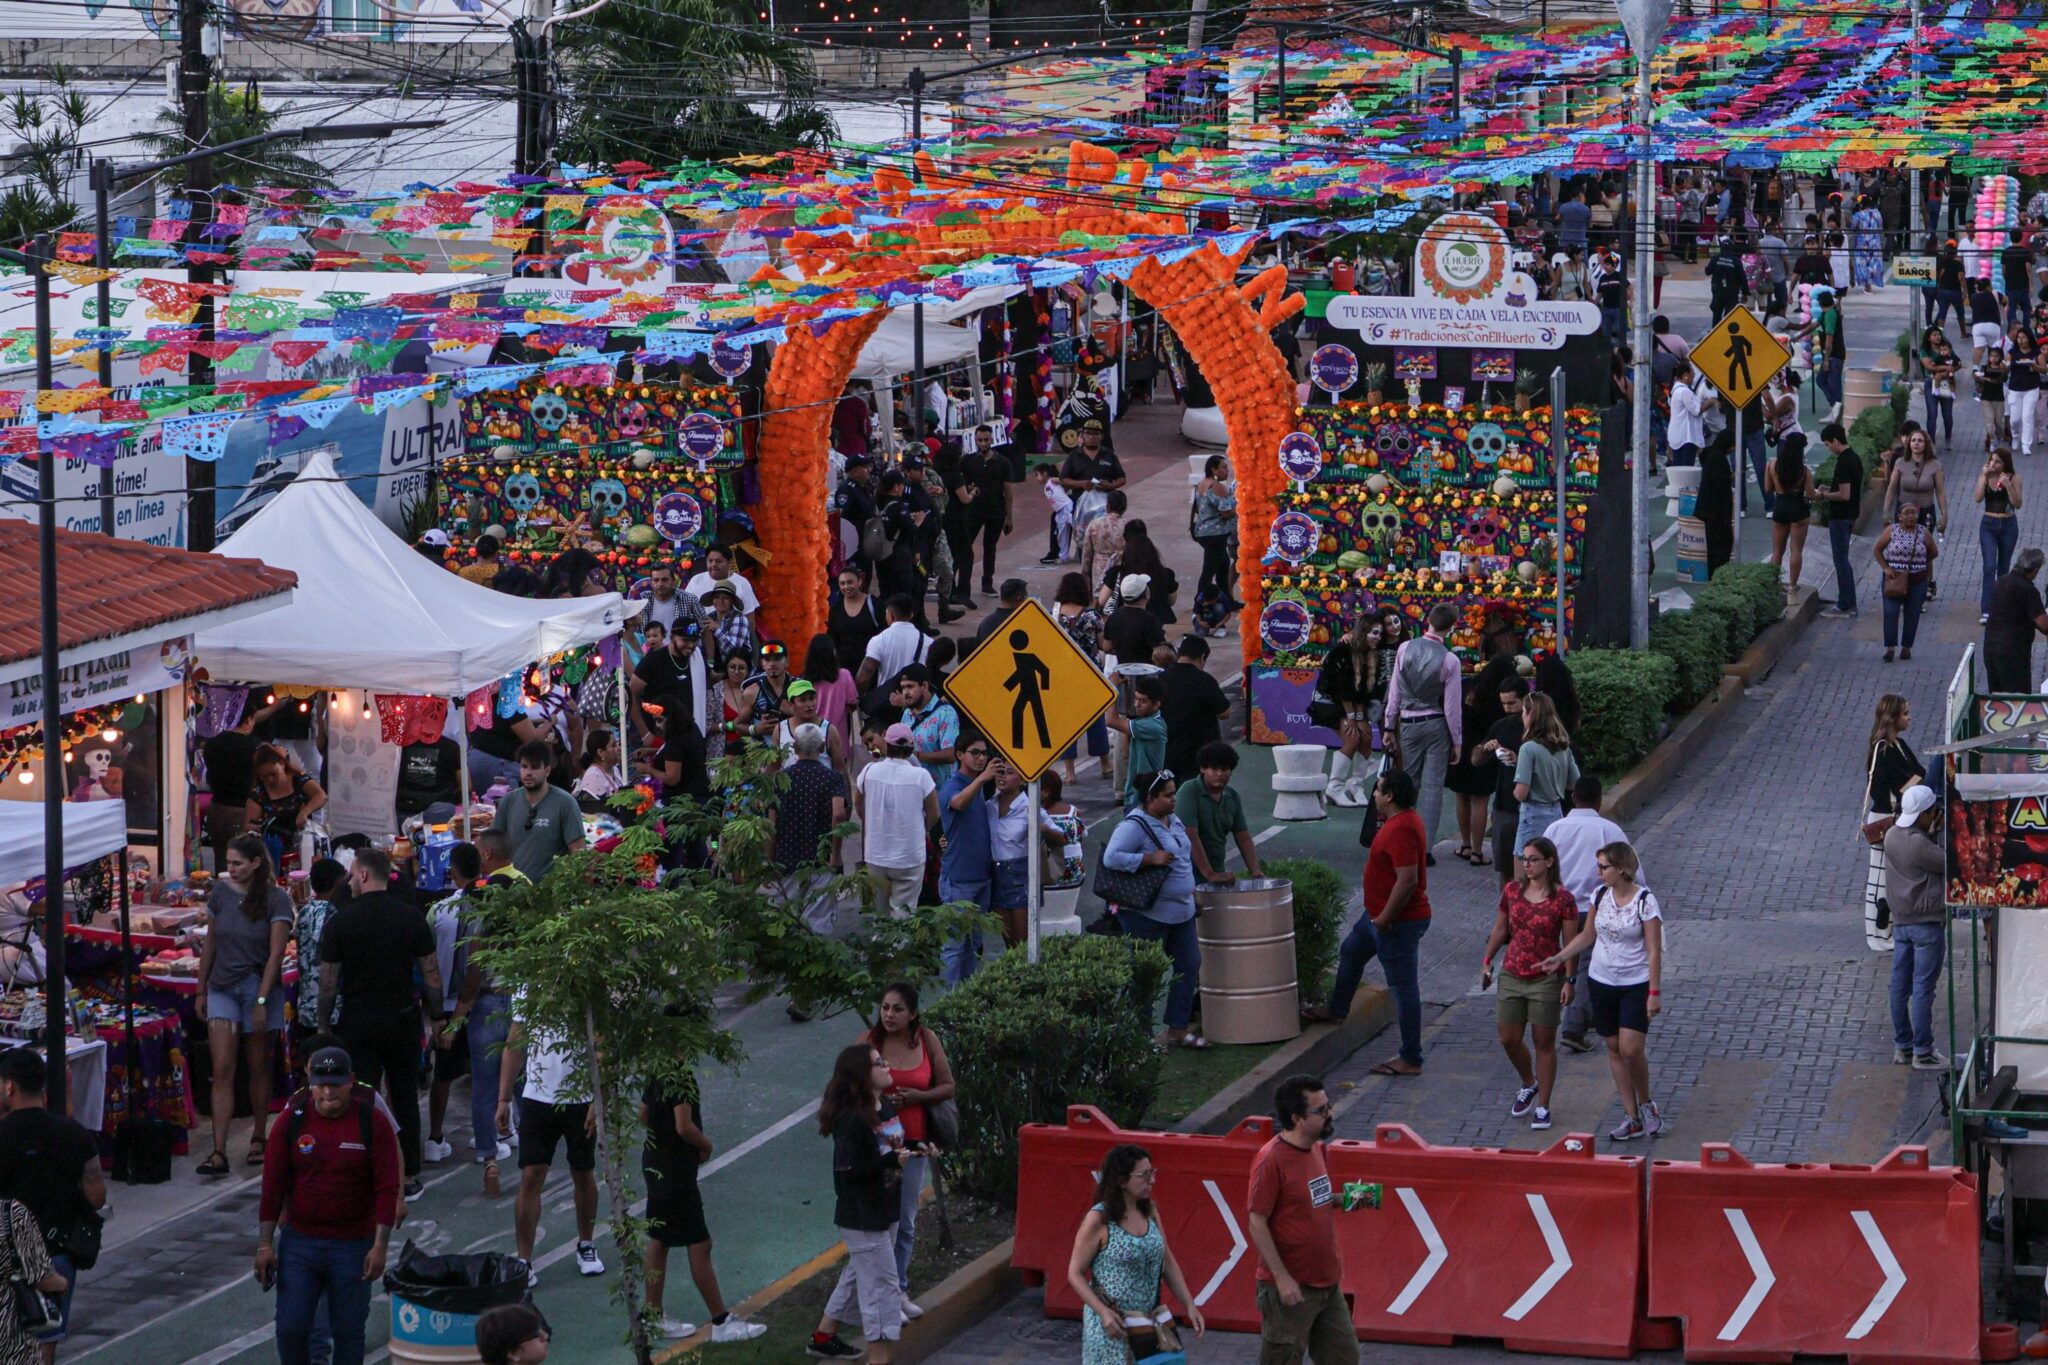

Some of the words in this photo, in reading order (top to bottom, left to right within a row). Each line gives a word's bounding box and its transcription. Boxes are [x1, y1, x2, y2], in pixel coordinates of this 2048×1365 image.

[1452, 257, 1484, 265] HUERTO
[1898, 267, 1931, 276] BAÑOS
[1343, 306, 1359, 318] TU
[1361, 307, 1407, 320] ESENCIA
[1411, 307, 1436, 320] VIVE
[1439, 309, 1454, 321] EN
[1456, 309, 1487, 322] CADA
[1490, 310, 1520, 323] VELA
[1523, 311, 1582, 324] ENCENDIDA
[1390, 328, 1535, 344] #TradicionesConElHuerto
[115, 468, 147, 494] time!
[117, 507, 132, 526] en
[135, 499, 165, 522] linea
